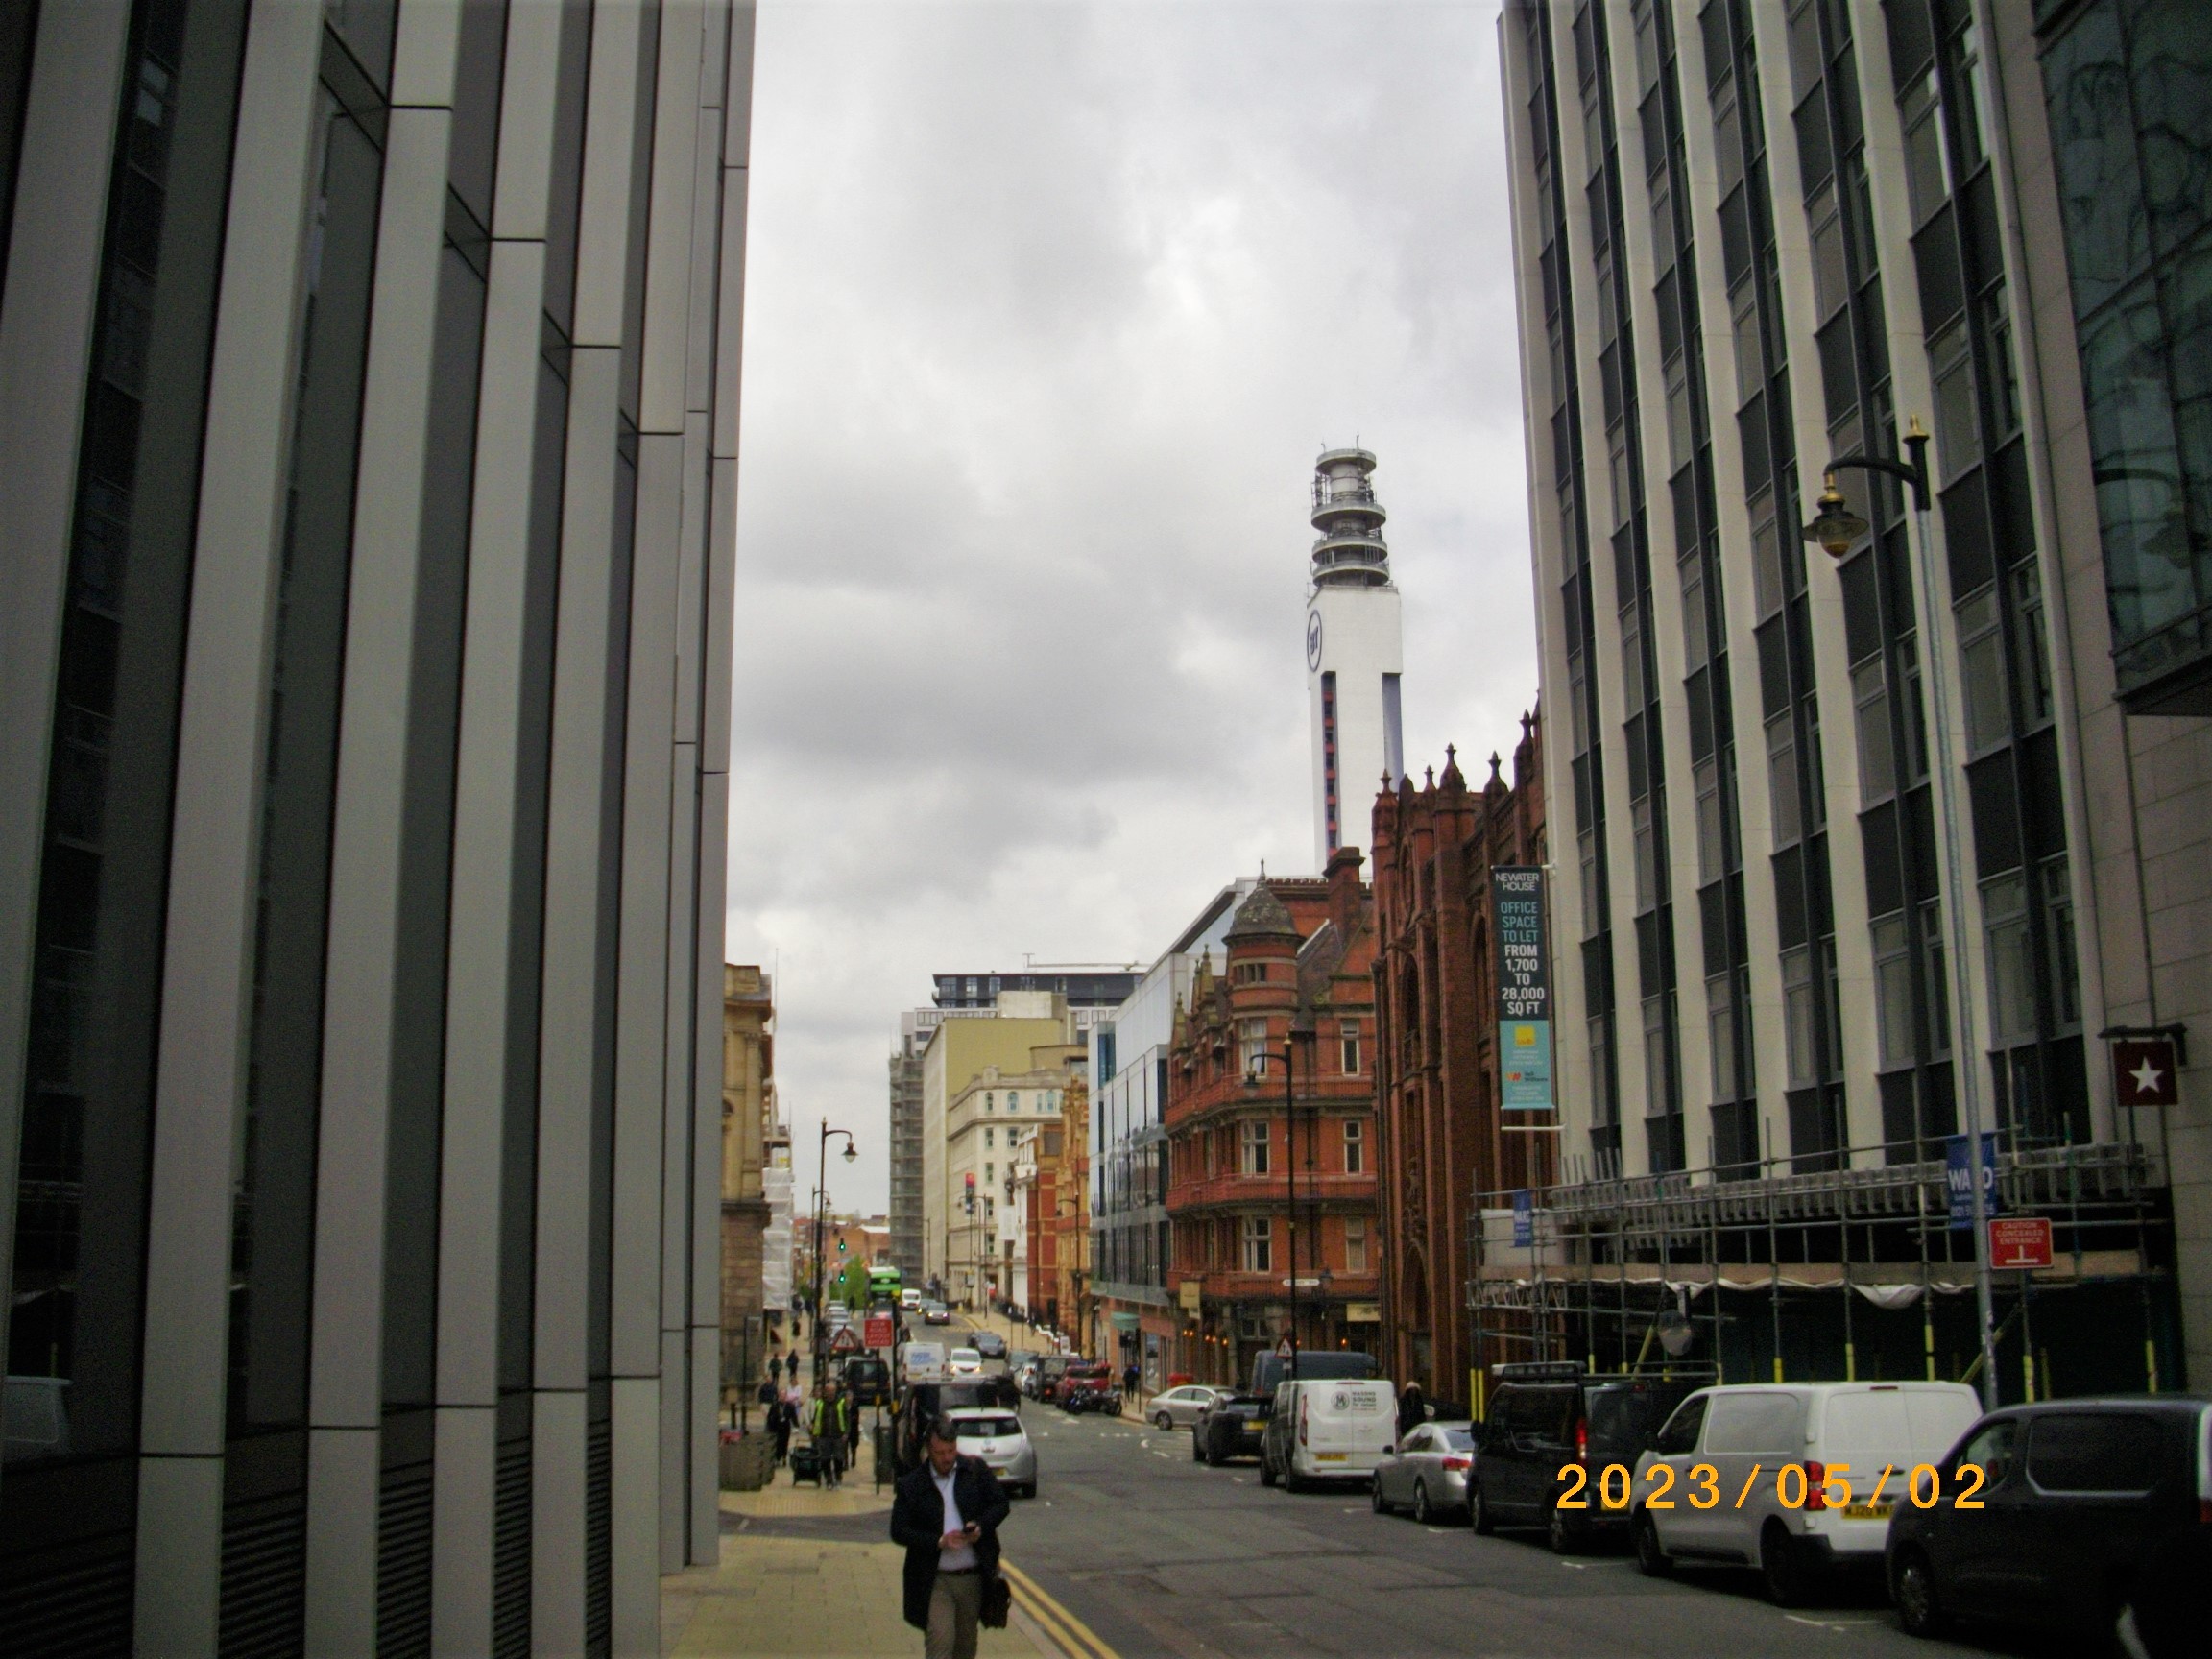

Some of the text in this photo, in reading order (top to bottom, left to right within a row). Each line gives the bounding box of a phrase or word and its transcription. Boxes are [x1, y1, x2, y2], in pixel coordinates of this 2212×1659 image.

[1495, 873, 1539, 881] NEWATER
[1502, 882, 1536, 891] HOUSE
[1500, 902, 1538, 914] OFFICE
[1502, 916, 1537, 928] SPACE
[1502, 930, 1538, 943] TO LET
[1504, 944, 1538, 957] FROM
[1505, 958, 1538, 973] 1,700
[1514, 973, 1530, 986] TO
[1502, 987, 1545, 1000] 28,000
[1506, 1001, 1540, 1017] SQ FT
[1948, 1166, 1993, 1191] WAD
[1999, 1237, 2043, 1245] ENTRANCE
